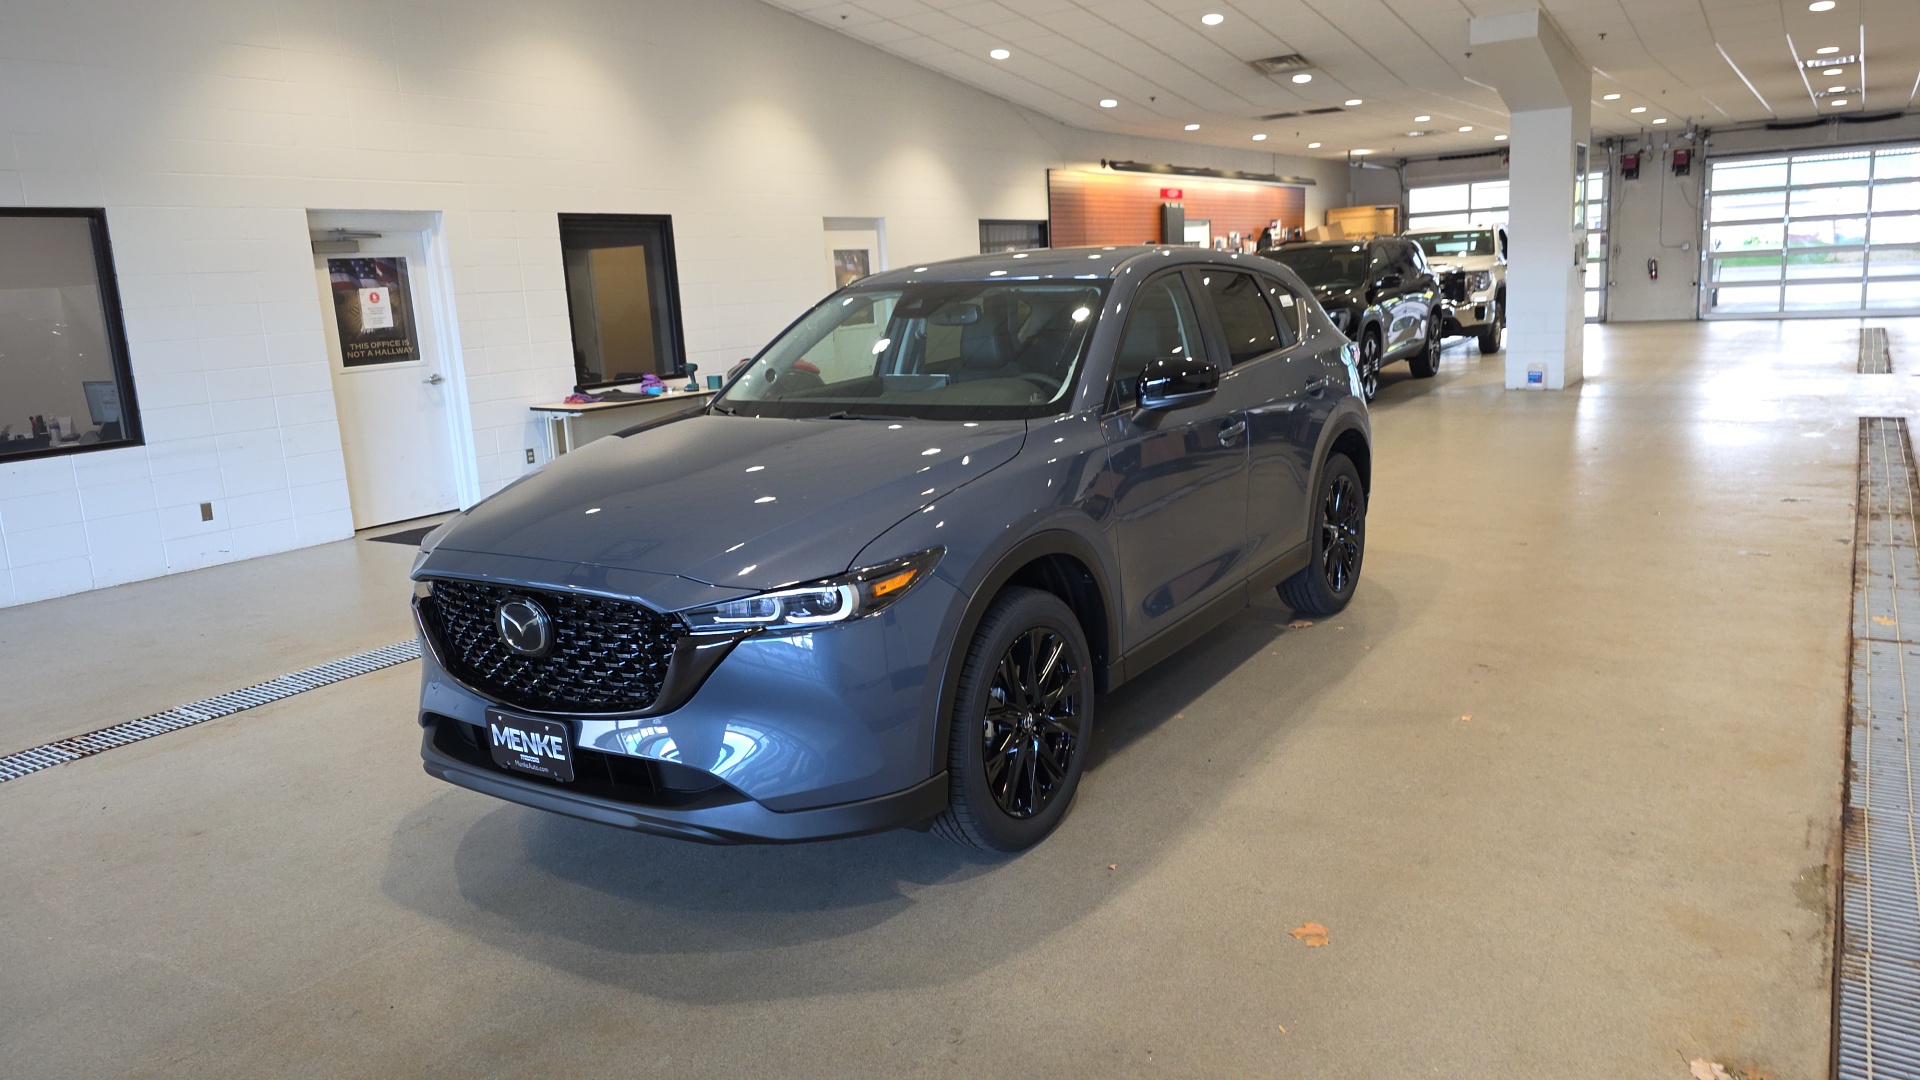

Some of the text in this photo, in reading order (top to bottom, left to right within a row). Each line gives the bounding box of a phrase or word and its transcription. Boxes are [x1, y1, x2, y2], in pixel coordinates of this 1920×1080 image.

[370, 340, 400, 348] OFFICE
[375, 347, 413, 356] HALLWAY
[491, 723, 565, 761] MENKE
